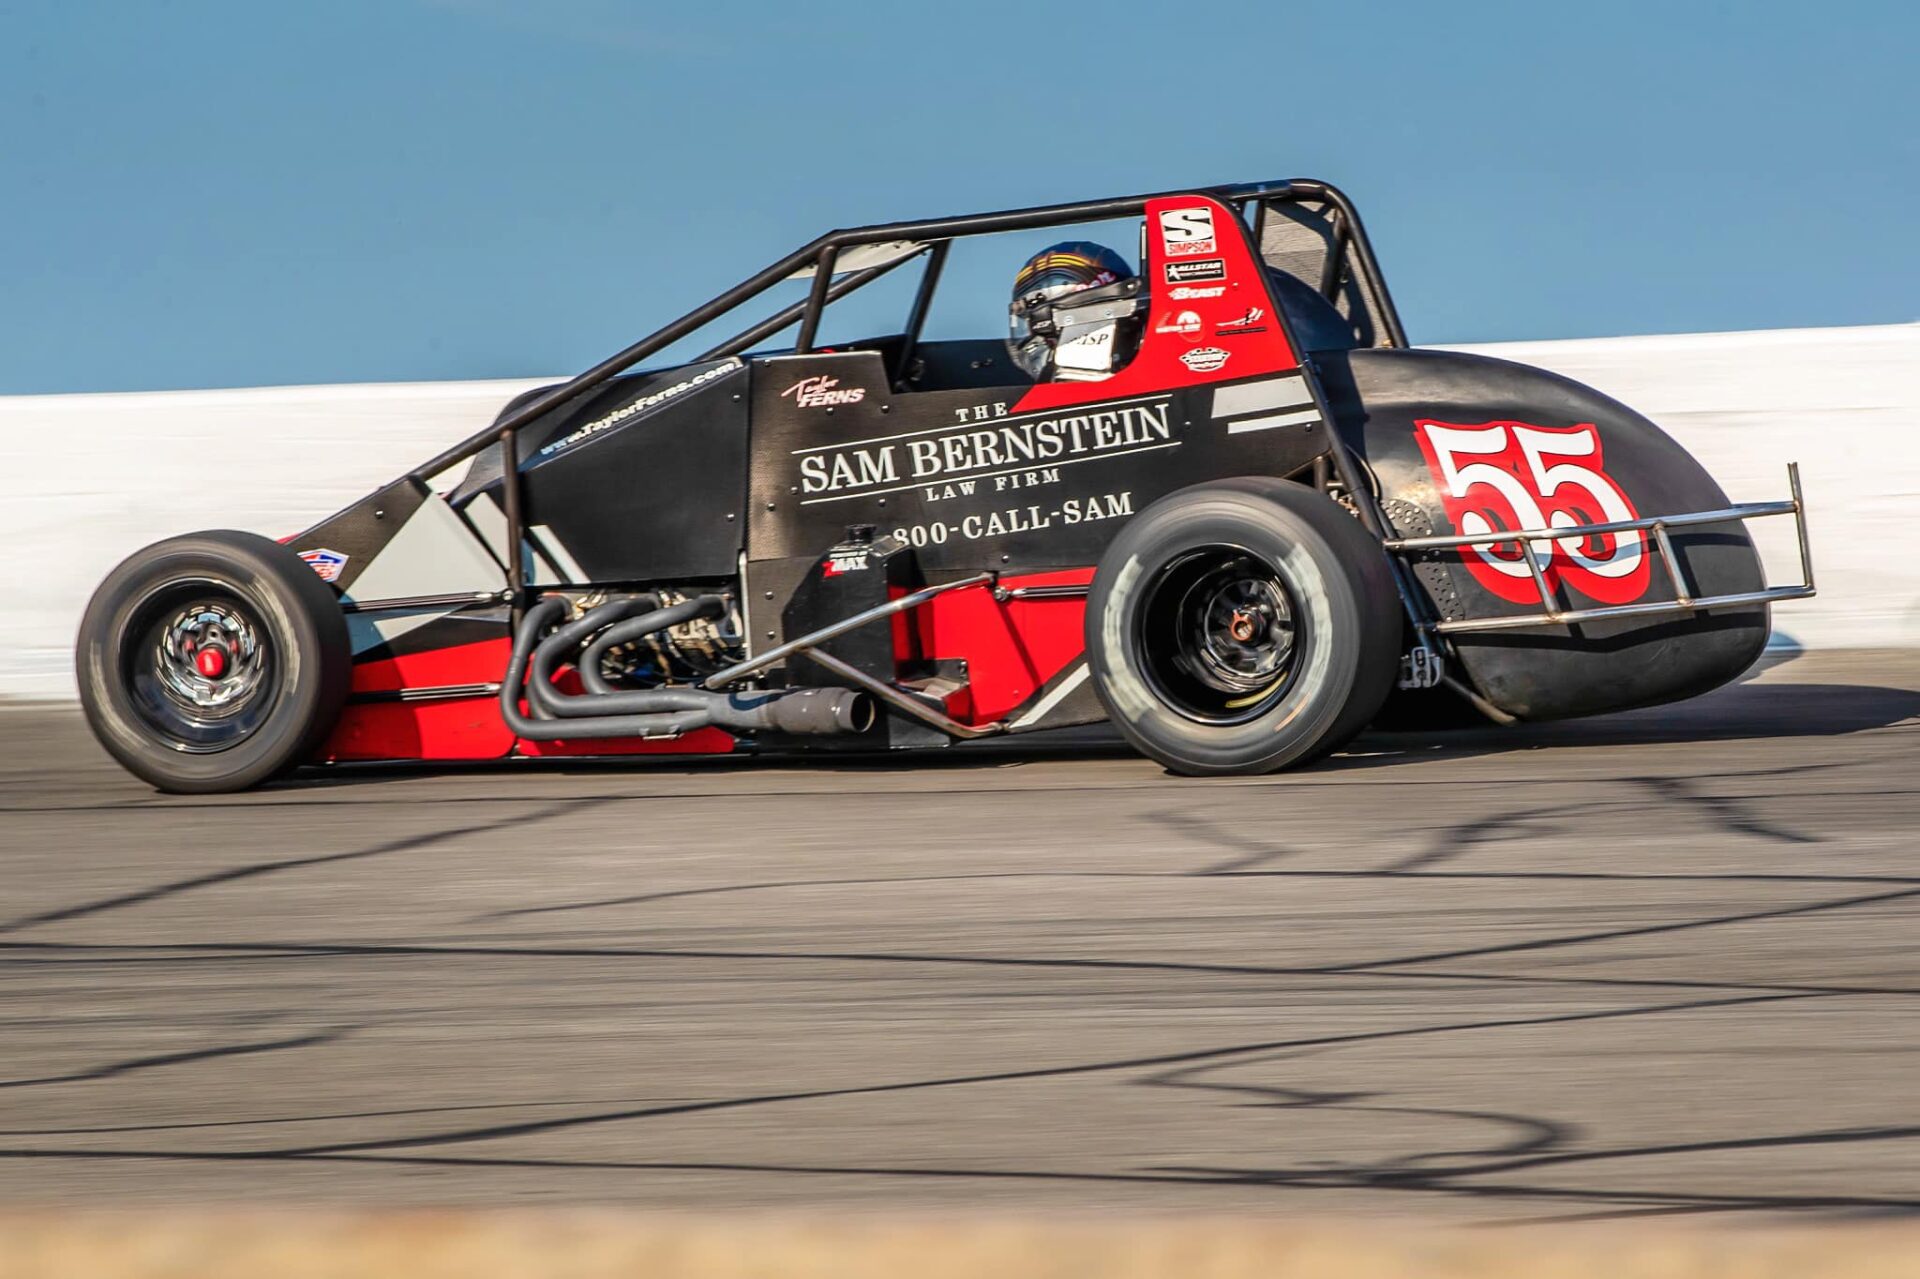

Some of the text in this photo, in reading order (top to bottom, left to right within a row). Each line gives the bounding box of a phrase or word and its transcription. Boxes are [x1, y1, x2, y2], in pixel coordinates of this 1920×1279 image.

[1168, 241, 1213, 255] SIMPSON
[798, 388, 866, 408] FERNS
[955, 402, 1008, 422] THE
[800, 403, 1173, 493] SAM BERNSTEIN
[926, 468, 1061, 502] LAW FIRM
[1421, 424, 1643, 580] 55
[892, 492, 1135, 548] 800-CALL-SAM
